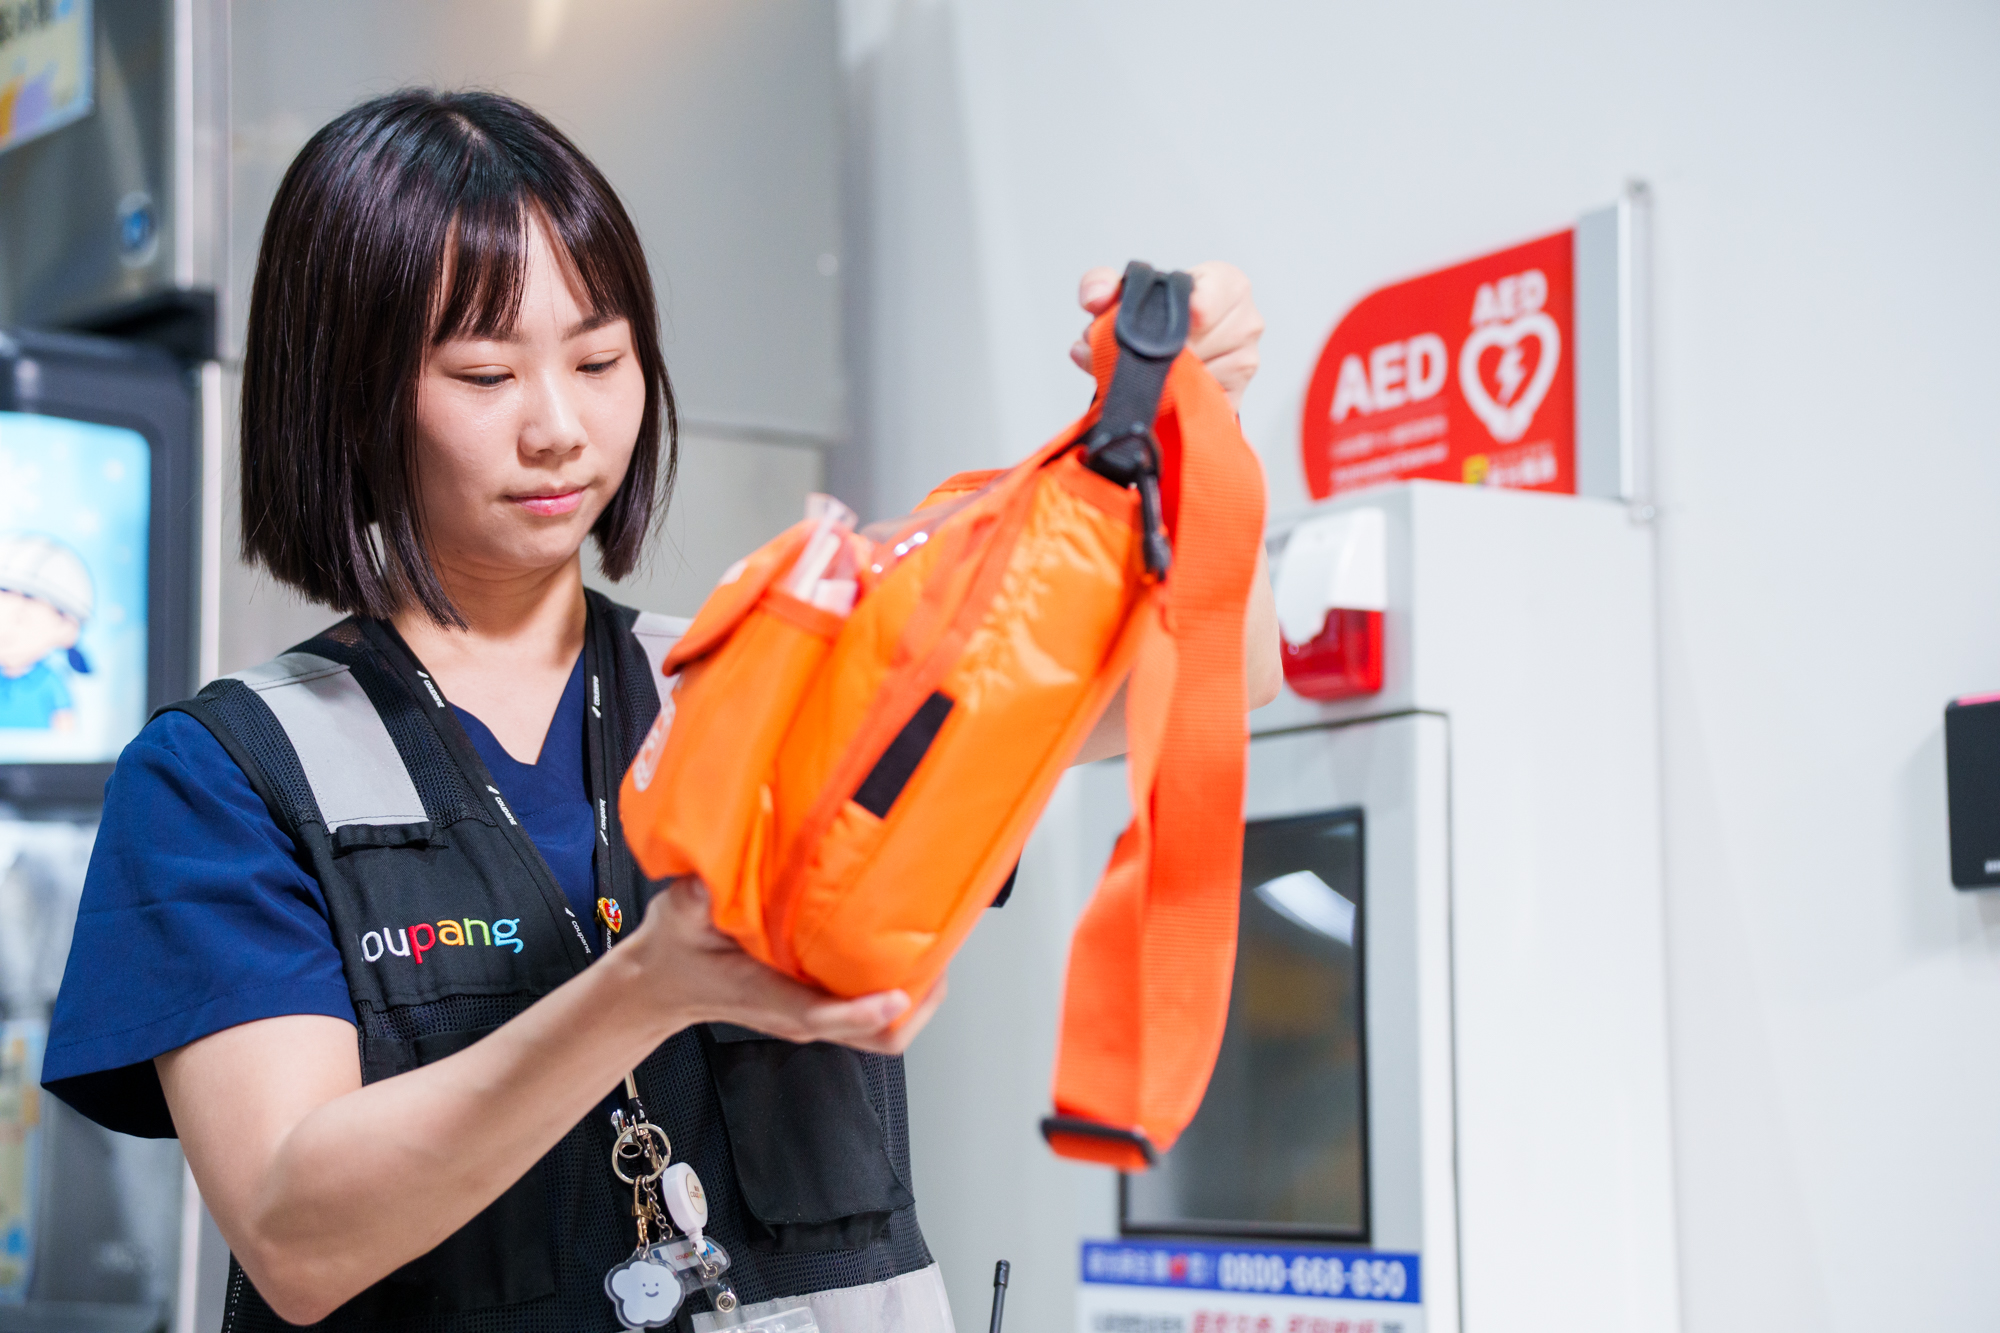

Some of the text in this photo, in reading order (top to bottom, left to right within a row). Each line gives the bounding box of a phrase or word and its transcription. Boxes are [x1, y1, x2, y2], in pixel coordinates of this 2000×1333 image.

[1470, 268, 1549, 328] AED
[1329, 332, 1449, 424] AED
[356, 917, 524, 965] oupang
[571, 920, 592, 954] coupang
[1217, 1252, 1407, 1299] 0800-668-850
